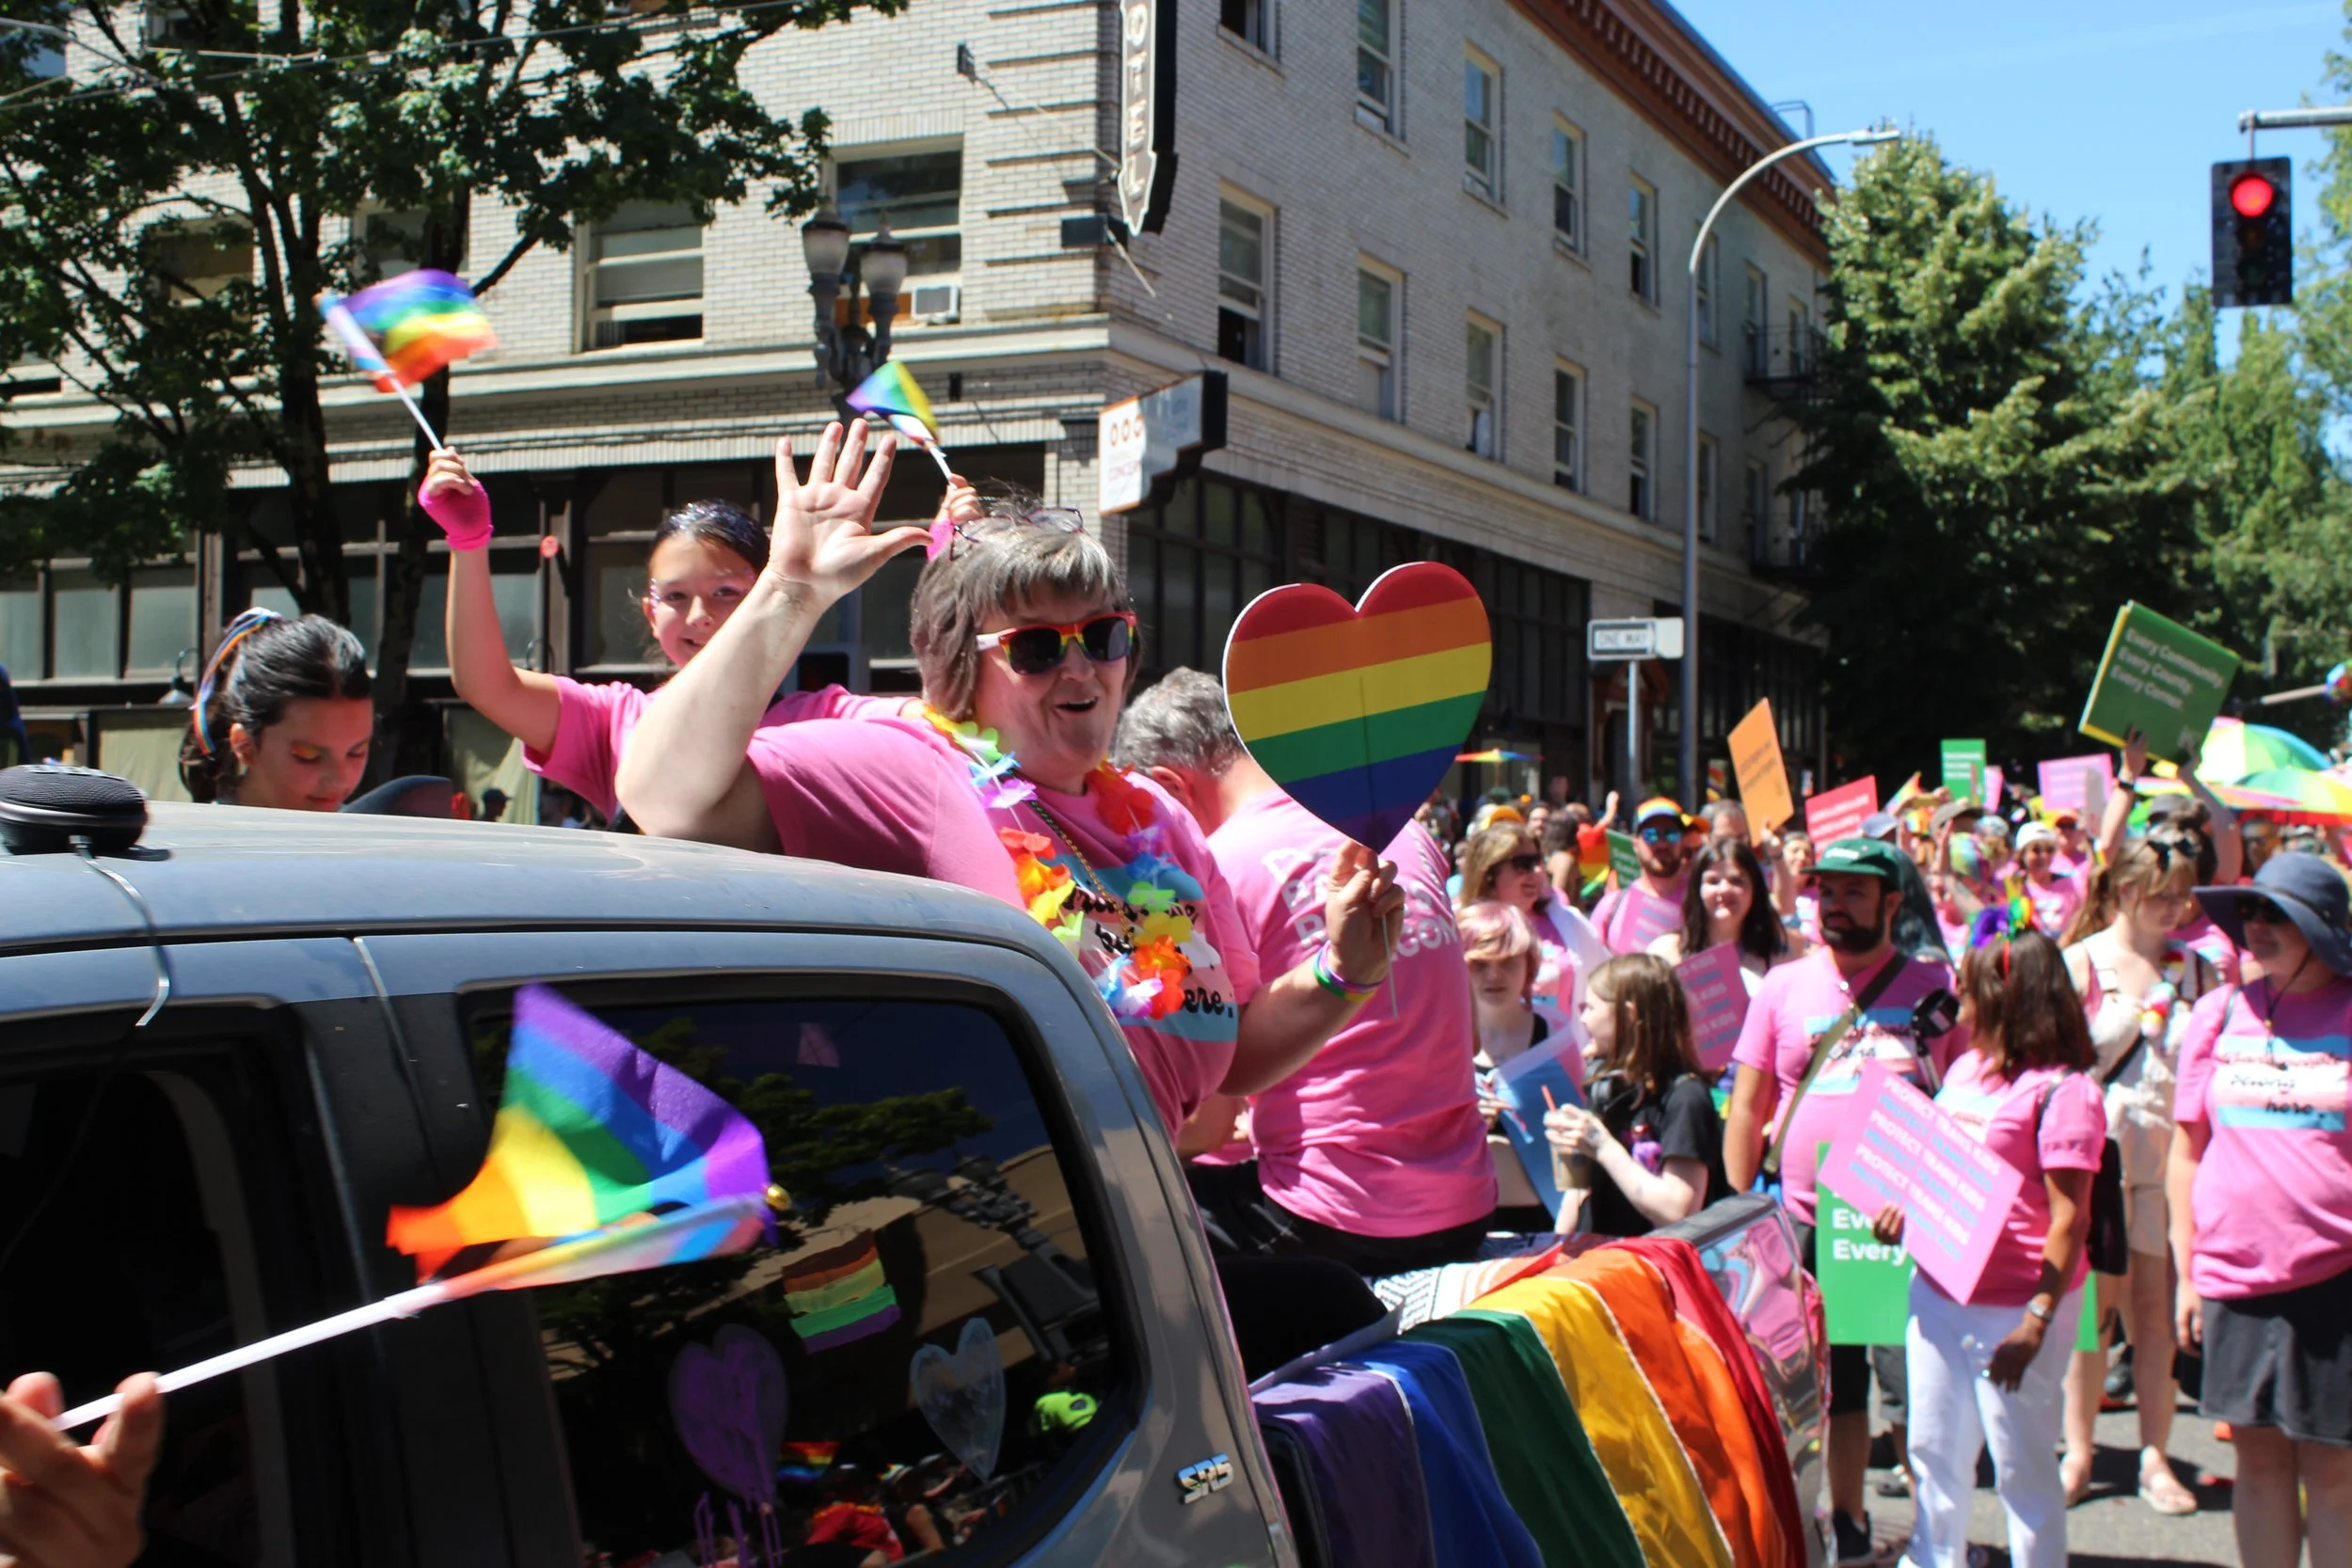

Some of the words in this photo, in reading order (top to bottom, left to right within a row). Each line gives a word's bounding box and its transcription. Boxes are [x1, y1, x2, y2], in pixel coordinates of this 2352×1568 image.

[2123, 626, 2159, 657] Every
[2116, 644, 2151, 675] Every
[2109, 663, 2144, 693] Every
[1181, 986, 1234, 1019] ere.
[1882, 1074, 1935, 1120] PROTECT
[1931, 1113, 1975, 1153] TRANS
[1969, 1145, 2002, 1176] KIDS
[1867, 1109, 1923, 1156] PROTECT
[1919, 1148, 1961, 1188] TRANS
[1955, 1180, 1988, 1212] KIDS
[1853, 1142, 1909, 1189] PROTECT
[1904, 1182, 1947, 1222] TRANS
[1940, 1213, 1972, 1245] KIDS
[1832, 1238, 1908, 1267] Every
